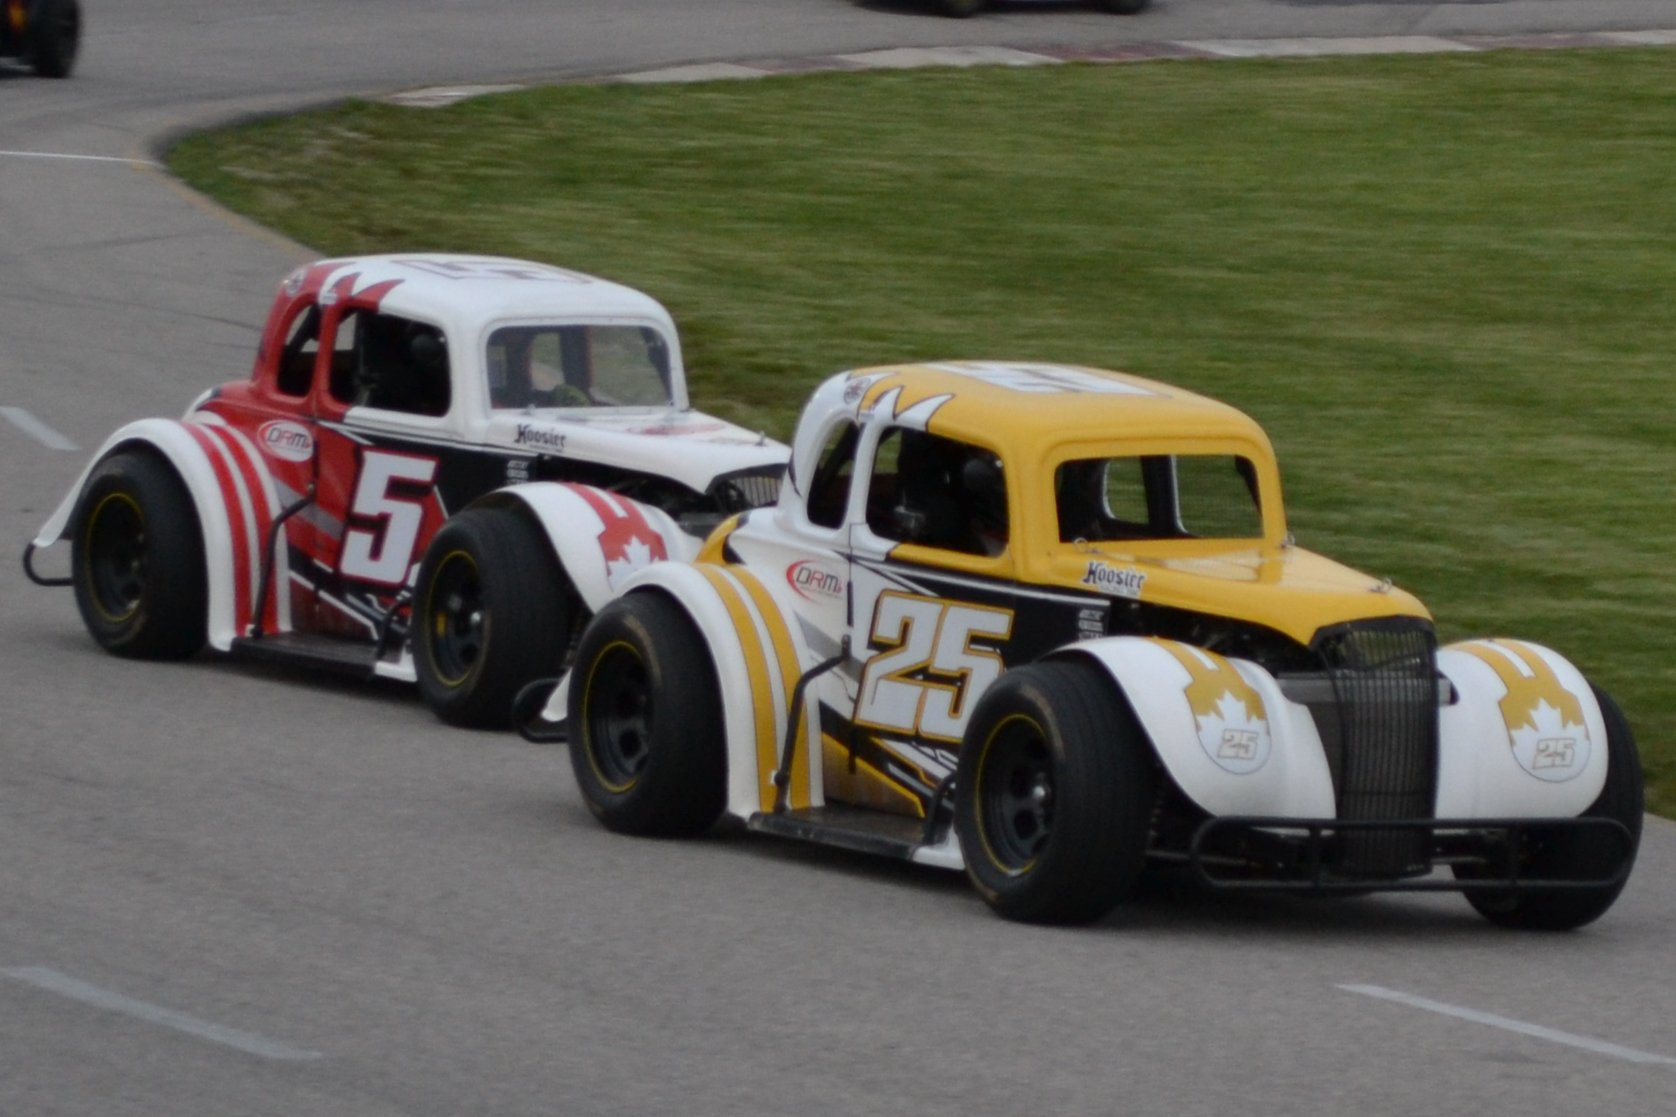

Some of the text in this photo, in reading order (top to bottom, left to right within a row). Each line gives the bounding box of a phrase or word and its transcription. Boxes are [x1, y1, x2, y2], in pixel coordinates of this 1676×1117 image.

[514, 424, 566, 447] Hoosier
[339, 449, 439, 584] 5
[1083, 561, 1145, 589] Hoosier
[853, 590, 1015, 742] 25
[1217, 728, 1259, 760] 25
[1532, 737, 1577, 769] 25
